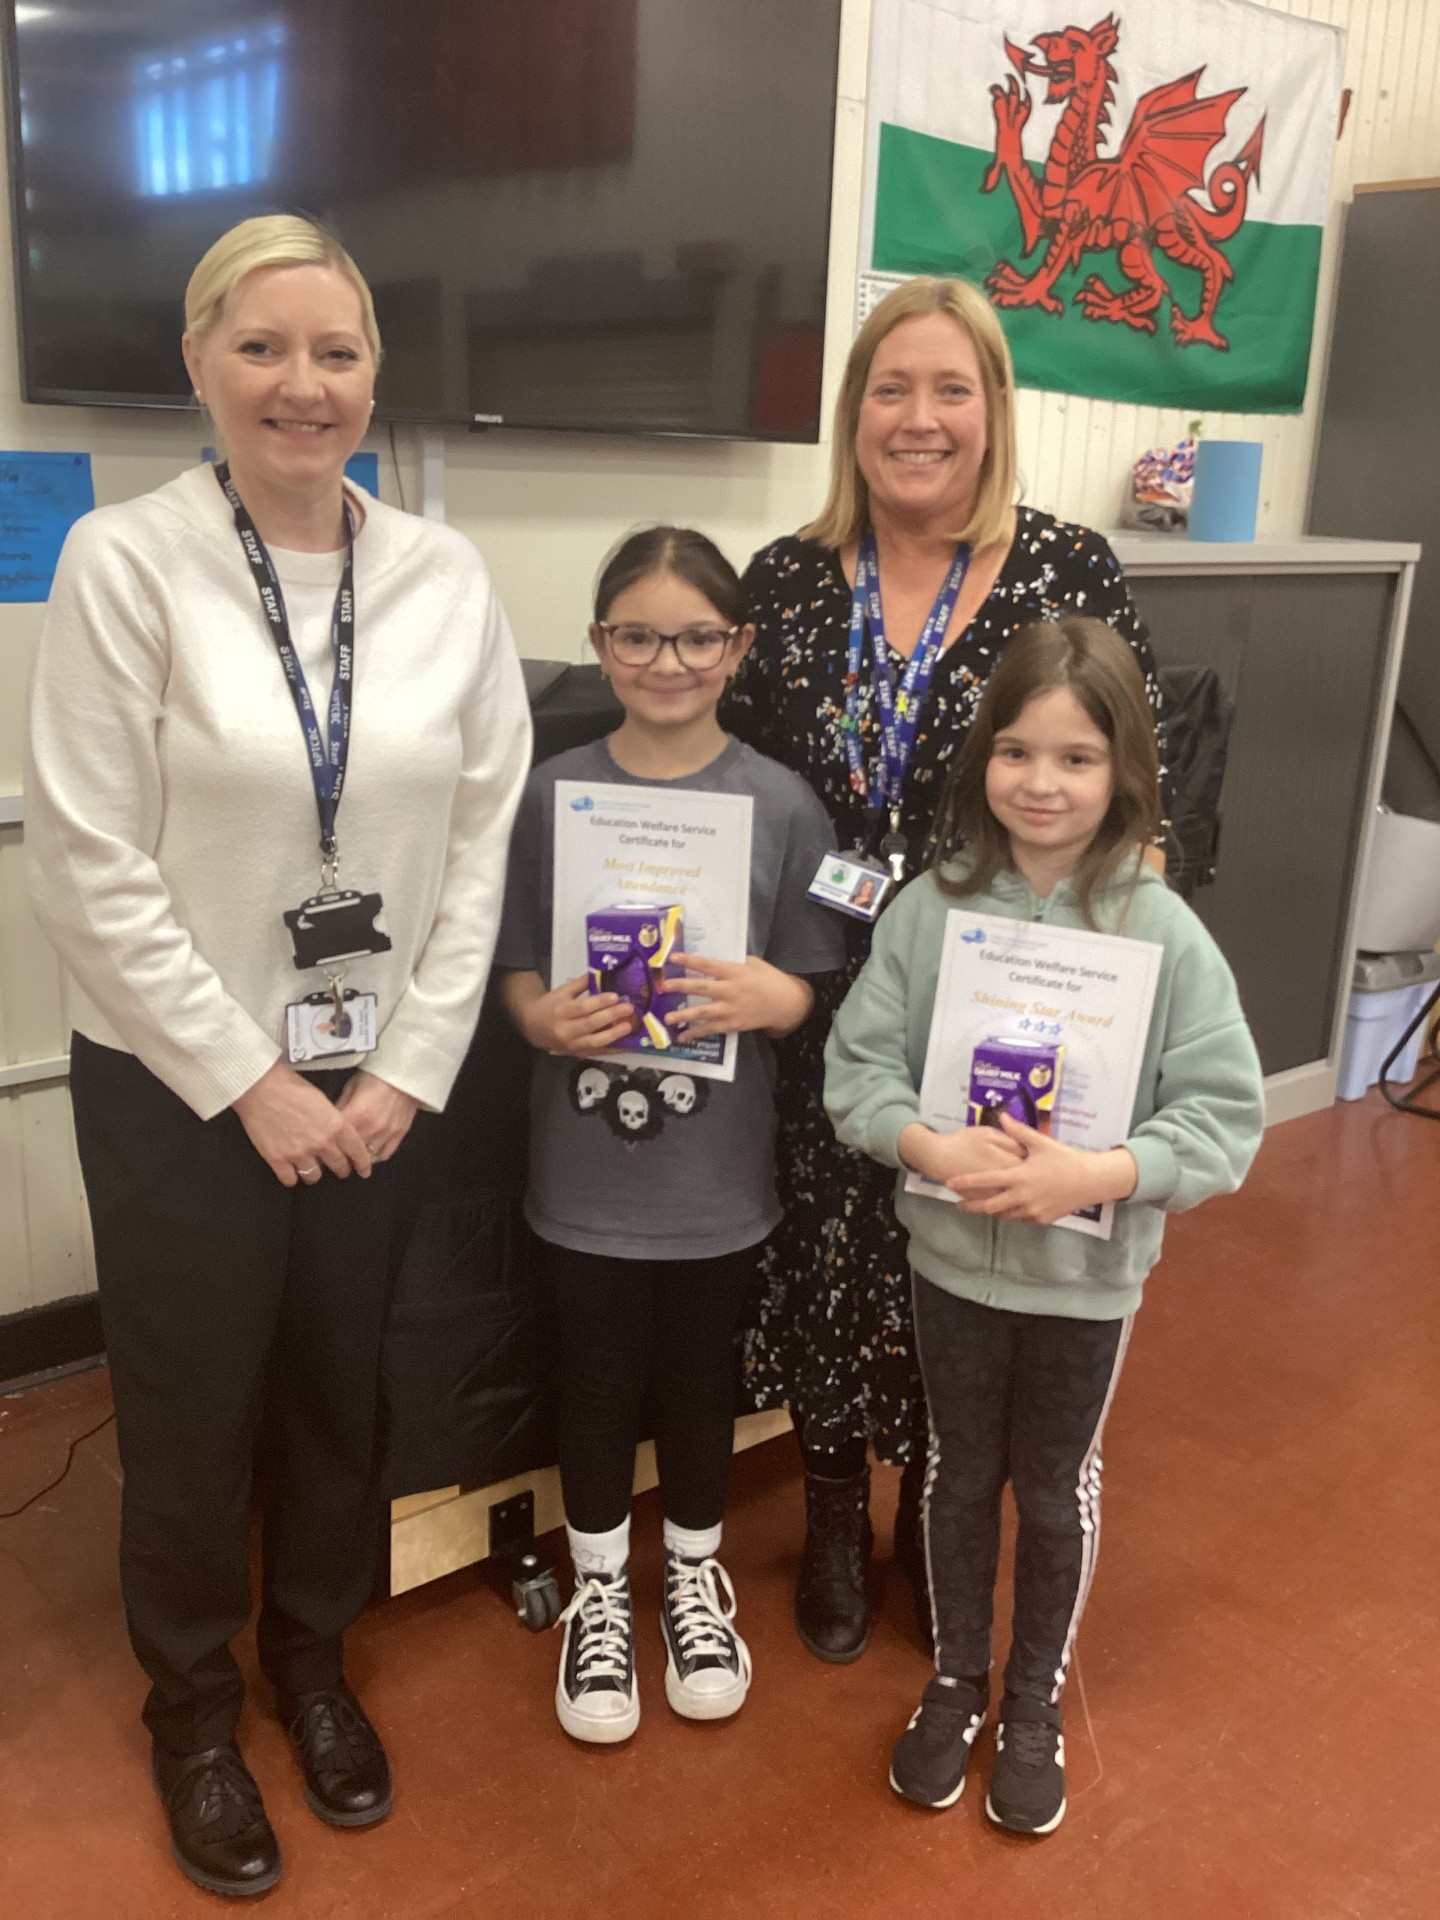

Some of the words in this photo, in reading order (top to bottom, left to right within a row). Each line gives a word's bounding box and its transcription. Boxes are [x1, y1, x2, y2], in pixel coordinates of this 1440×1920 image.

[241, 529, 263, 565] STAFF
[261, 586, 282, 624] STAFF
[340, 589, 353, 623] STAFF
[851, 602, 863, 631] STAFF
[869, 591, 881, 619] STAFF
[934, 604, 949, 633] STAFF
[339, 644, 352, 680] STAFF
[873, 635, 887, 664] STAFF
[879, 680, 892, 709] STAFF
[308, 727, 324, 767] NPTCBC
[885, 726, 898, 758] STAFF
[590, 815, 638, 829] Education
[640, 819, 679, 833] Welfare
[681, 823, 716, 836] Service
[618, 834, 669, 848] Certificate
[671, 838, 686, 849] for
[602, 857, 635, 872] Most
[639, 861, 702, 877] Improved
[617, 878, 688, 895] Attendance
[979, 949, 1031, 968] Education
[1034, 958, 1077, 976] Welfare
[1079, 966, 1118, 983] Service
[1008, 971, 1064, 991] Certificate
[1066, 980, 1083, 993] for
[971, 991, 1027, 1015] Shining
[1031, 1002, 1062, 1017] Star
[1067, 1009, 1115, 1028] Award
